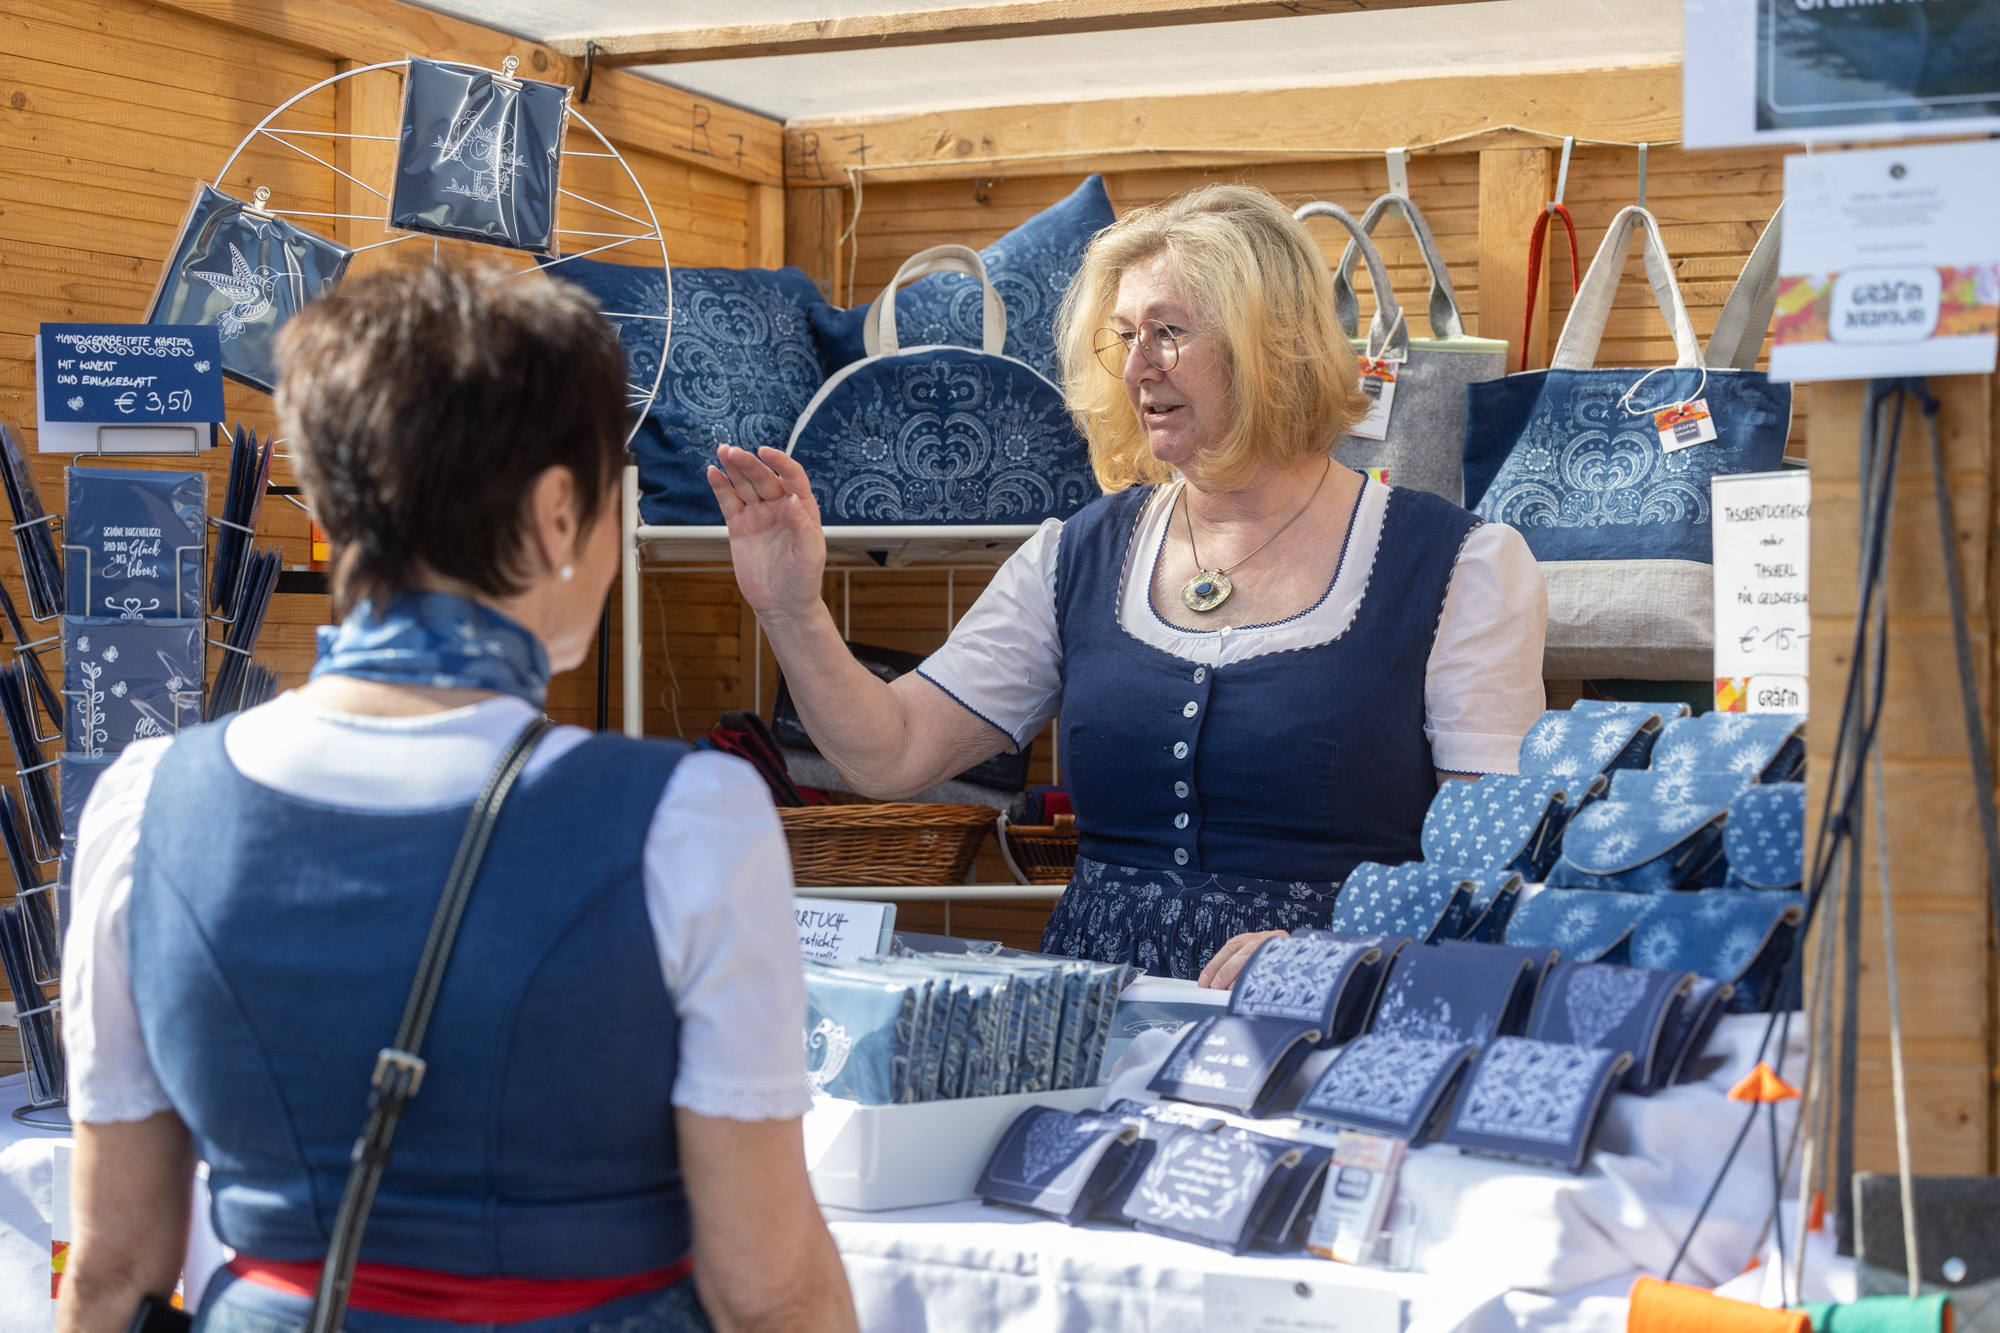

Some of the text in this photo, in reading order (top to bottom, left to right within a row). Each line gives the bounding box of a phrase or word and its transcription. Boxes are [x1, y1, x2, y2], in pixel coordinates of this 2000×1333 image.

[691, 104, 744, 168] R 7
[799, 132, 828, 180] R
[55, 333, 193, 348] HANDGEARBEITETE KARTEN
[58, 359, 118, 372] MIT KUVERT
[57, 374, 158, 388] UND EINLAGEBLATT
[114, 389, 192, 415] € 3,50
[116, 554, 127, 564] DES
[117, 541, 128, 552] DAS
[129, 539, 162, 561] Glück
[1754, 563, 1797, 579] TASCHERL
[1739, 626, 1760, 653] €
